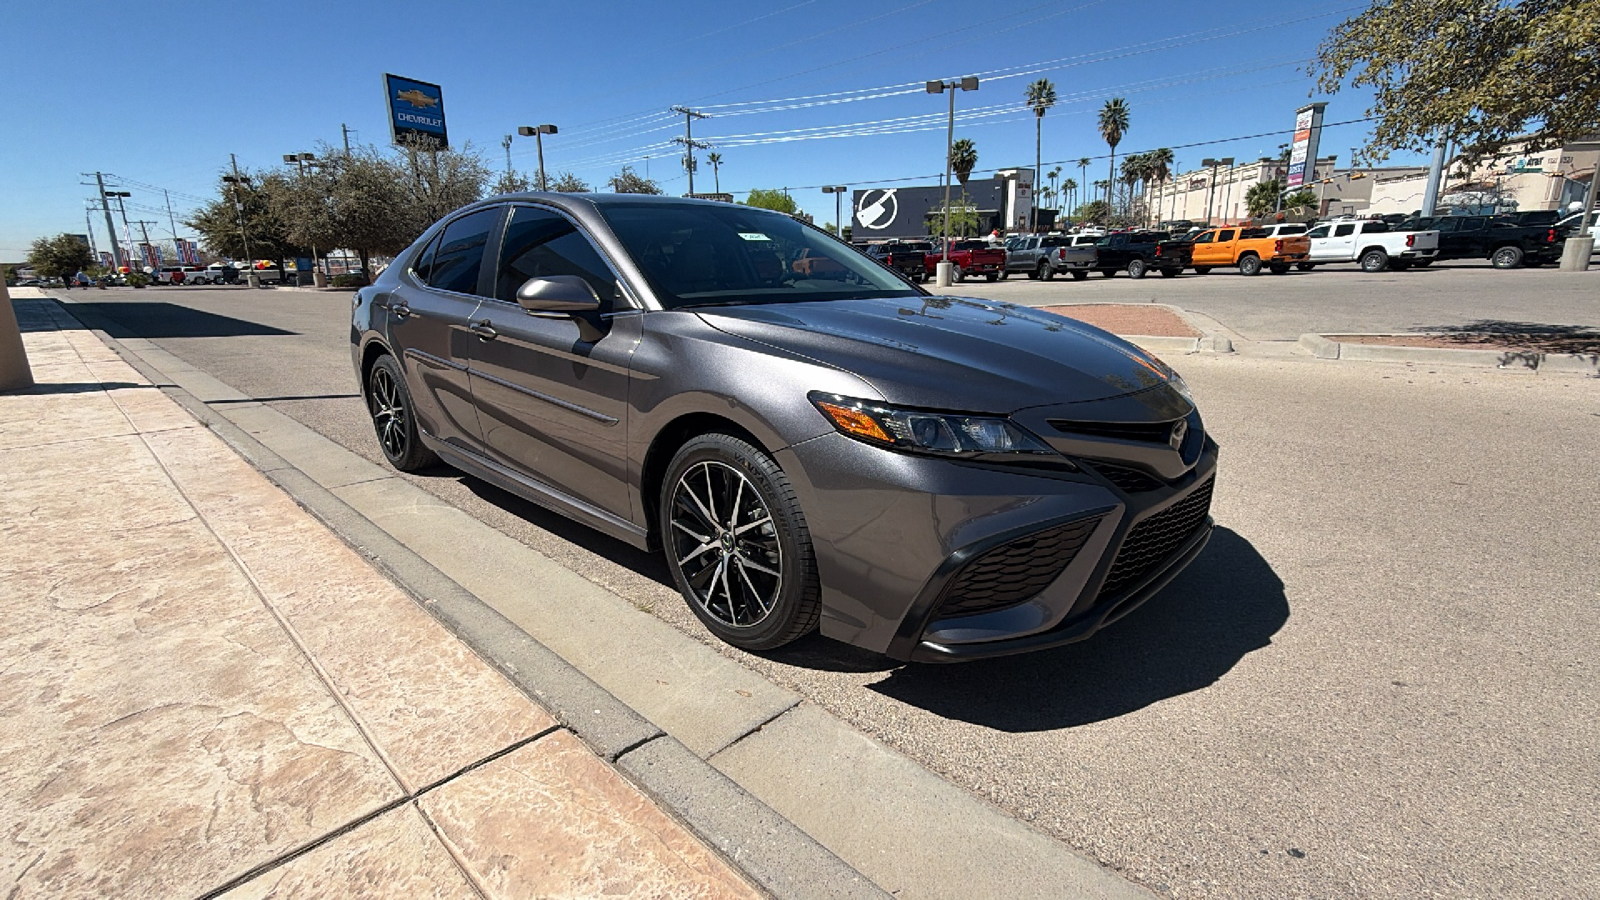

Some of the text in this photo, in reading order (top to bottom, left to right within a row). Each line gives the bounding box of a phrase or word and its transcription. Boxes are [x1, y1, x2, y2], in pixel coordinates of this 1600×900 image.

[397, 112, 442, 127] CHEVROLET
[1526, 156, 1544, 167] AT&T
[734, 451, 778, 502] VANTAGE
